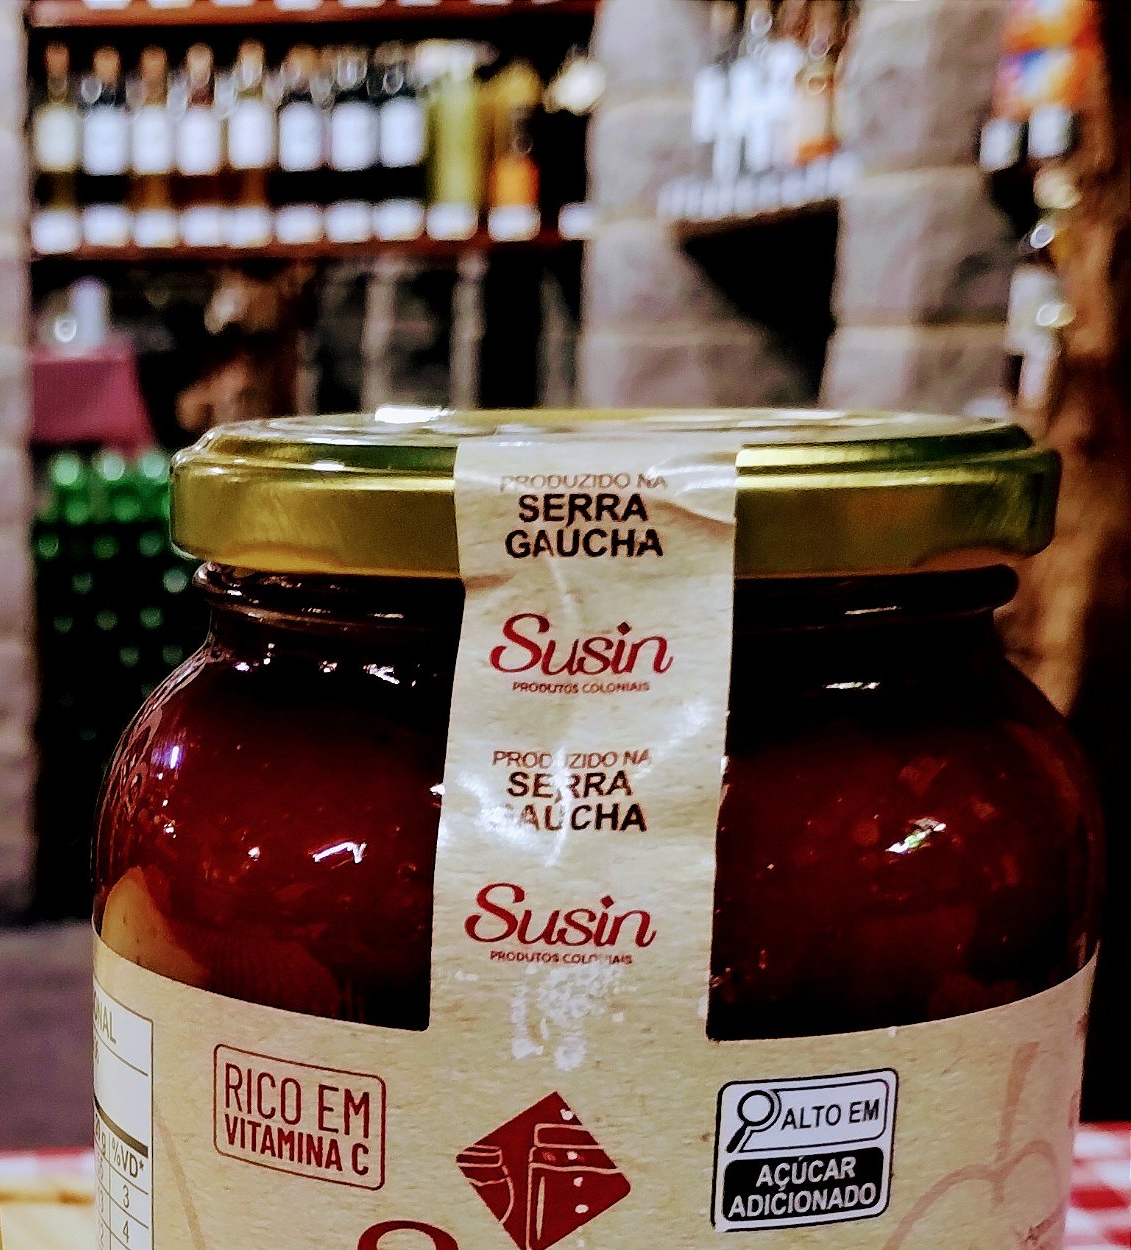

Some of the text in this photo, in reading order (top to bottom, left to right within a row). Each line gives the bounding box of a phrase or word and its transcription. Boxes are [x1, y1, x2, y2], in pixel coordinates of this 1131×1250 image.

[518, 493, 649, 526] SERRA
[504, 528, 664, 558] GAUCHA
[488, 612, 674, 676] Susin
[512, 681, 650, 695] PRODUTOS COLONIAIS
[492, 749, 652, 769] PRODZIDO NA
[504, 802, 648, 832] AUCHA
[463, 882, 657, 948] Susin
[490, 950, 560, 963] PRODUTOS
[224, 1062, 371, 1140] RICO EM
[780, 1098, 881, 1131] ALTO EM
[224, 1113, 370, 1176] VITAMINA C
[755, 1155, 858, 1192] AÇÚCAR
[122, 1184, 130, 1209] 3
[727, 1182, 878, 1218] ADICIONADO
[122, 1219, 130, 1243] 4
